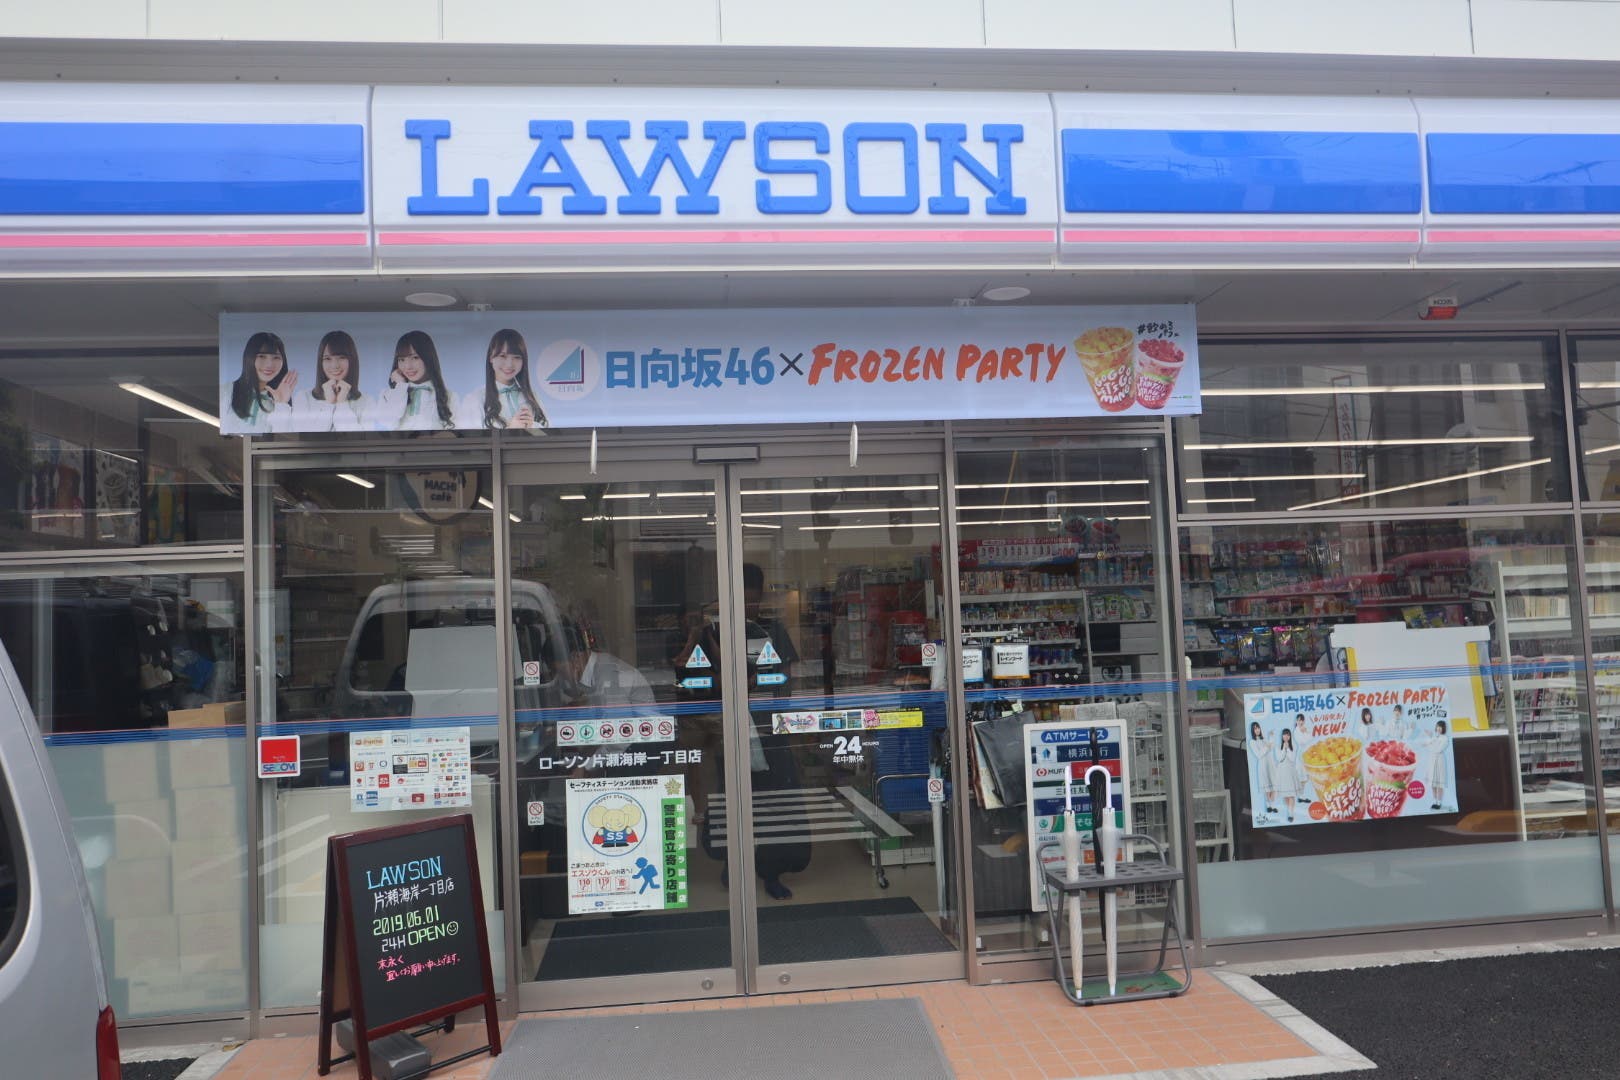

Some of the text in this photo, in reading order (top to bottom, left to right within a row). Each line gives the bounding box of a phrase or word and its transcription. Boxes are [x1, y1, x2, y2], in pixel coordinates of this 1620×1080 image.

[405, 119, 1027, 216] LAWSON
[606, 346, 775, 389] 日向坂46
[808, 343, 945, 386] FROZEN
[956, 343, 1066, 384] PARTY
[1271, 694, 1335, 713] 日向坂46
[1348, 690, 1399, 709] FROZEN
[1403, 687, 1446, 705] PARTY
[1312, 721, 1346, 737] NEW!
[834, 735, 863, 755] 24
[263, 763, 296, 772] SECOM
[539, 749, 702, 770] ローソン片瀬海岸一丁目店
[607, 832, 624, 841] SS
[366, 856, 442, 889] LAWSON
[374, 877, 455, 912] 片瀬海岸一丁目店
[373, 905, 439, 936] 2019.06.01
[381, 923, 446, 952] 24H OPEN
